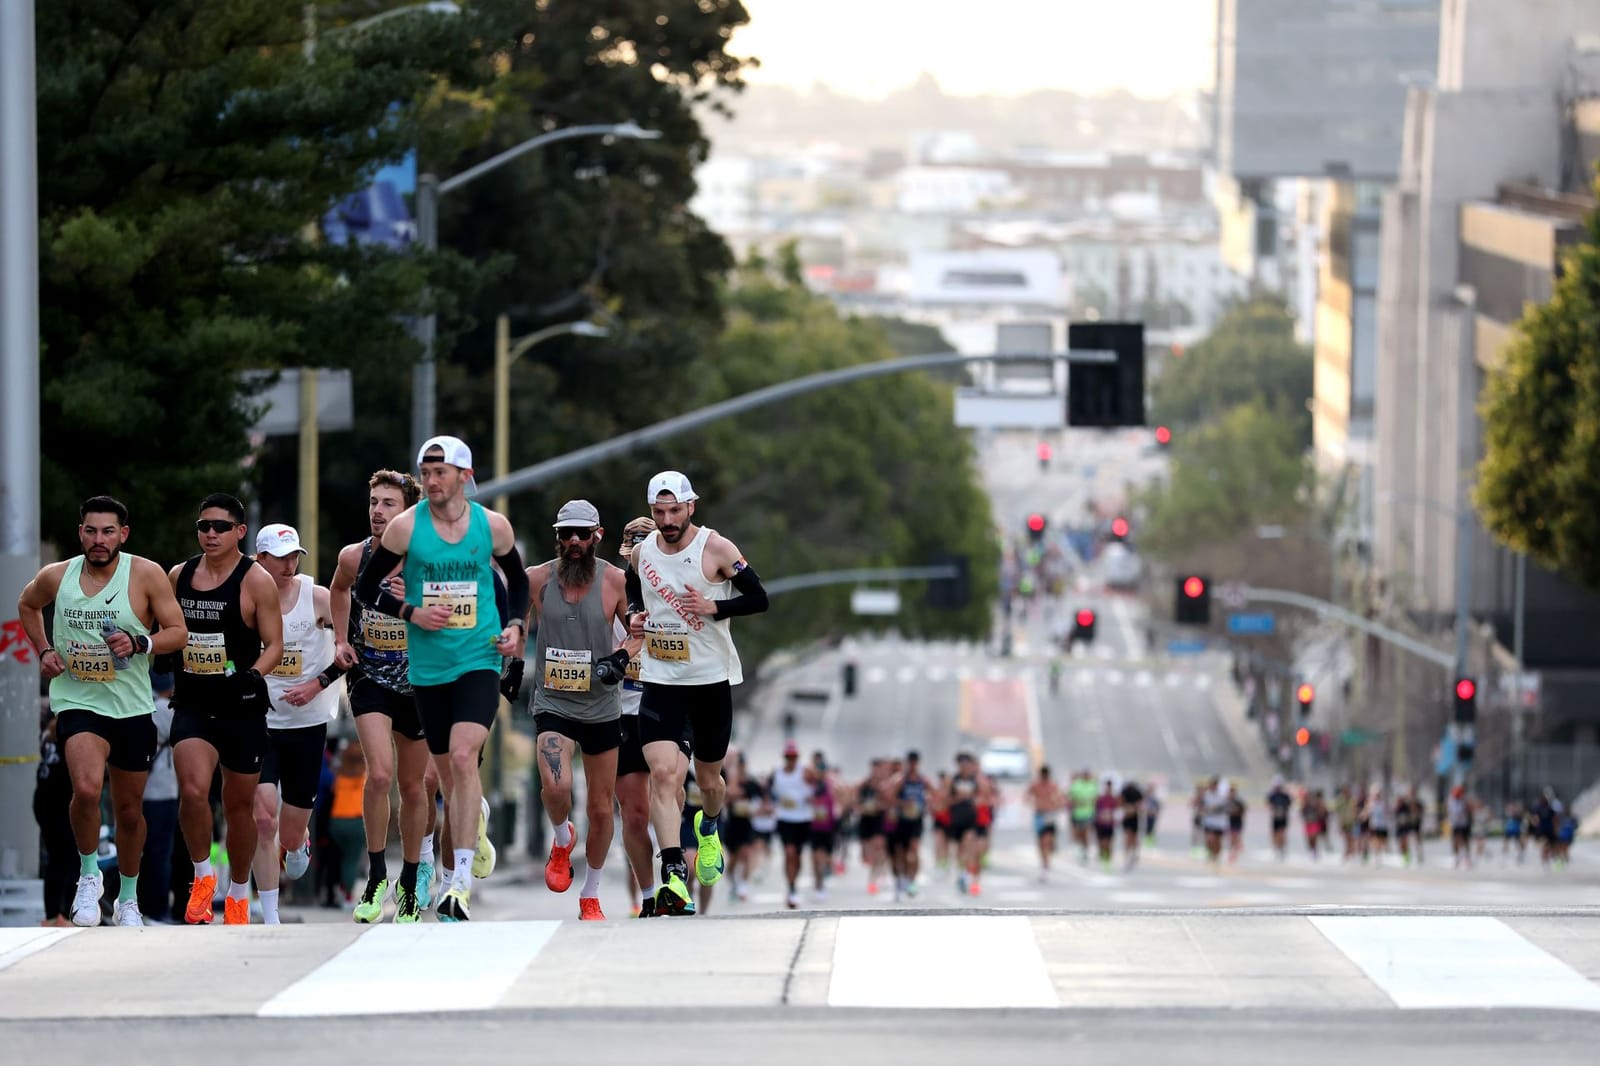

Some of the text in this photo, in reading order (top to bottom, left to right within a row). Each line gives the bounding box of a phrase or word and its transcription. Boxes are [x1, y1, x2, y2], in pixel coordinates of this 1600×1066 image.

[643, 562, 662, 587] LOS
[657, 585, 705, 631] ANGELES
[68, 619, 95, 630] SANTA
[368, 628, 405, 640] E8369
[651, 638, 684, 650] A1353
[187, 652, 222, 663] A1548
[72, 659, 109, 672] A1243
[550, 667, 586, 680] A1394
